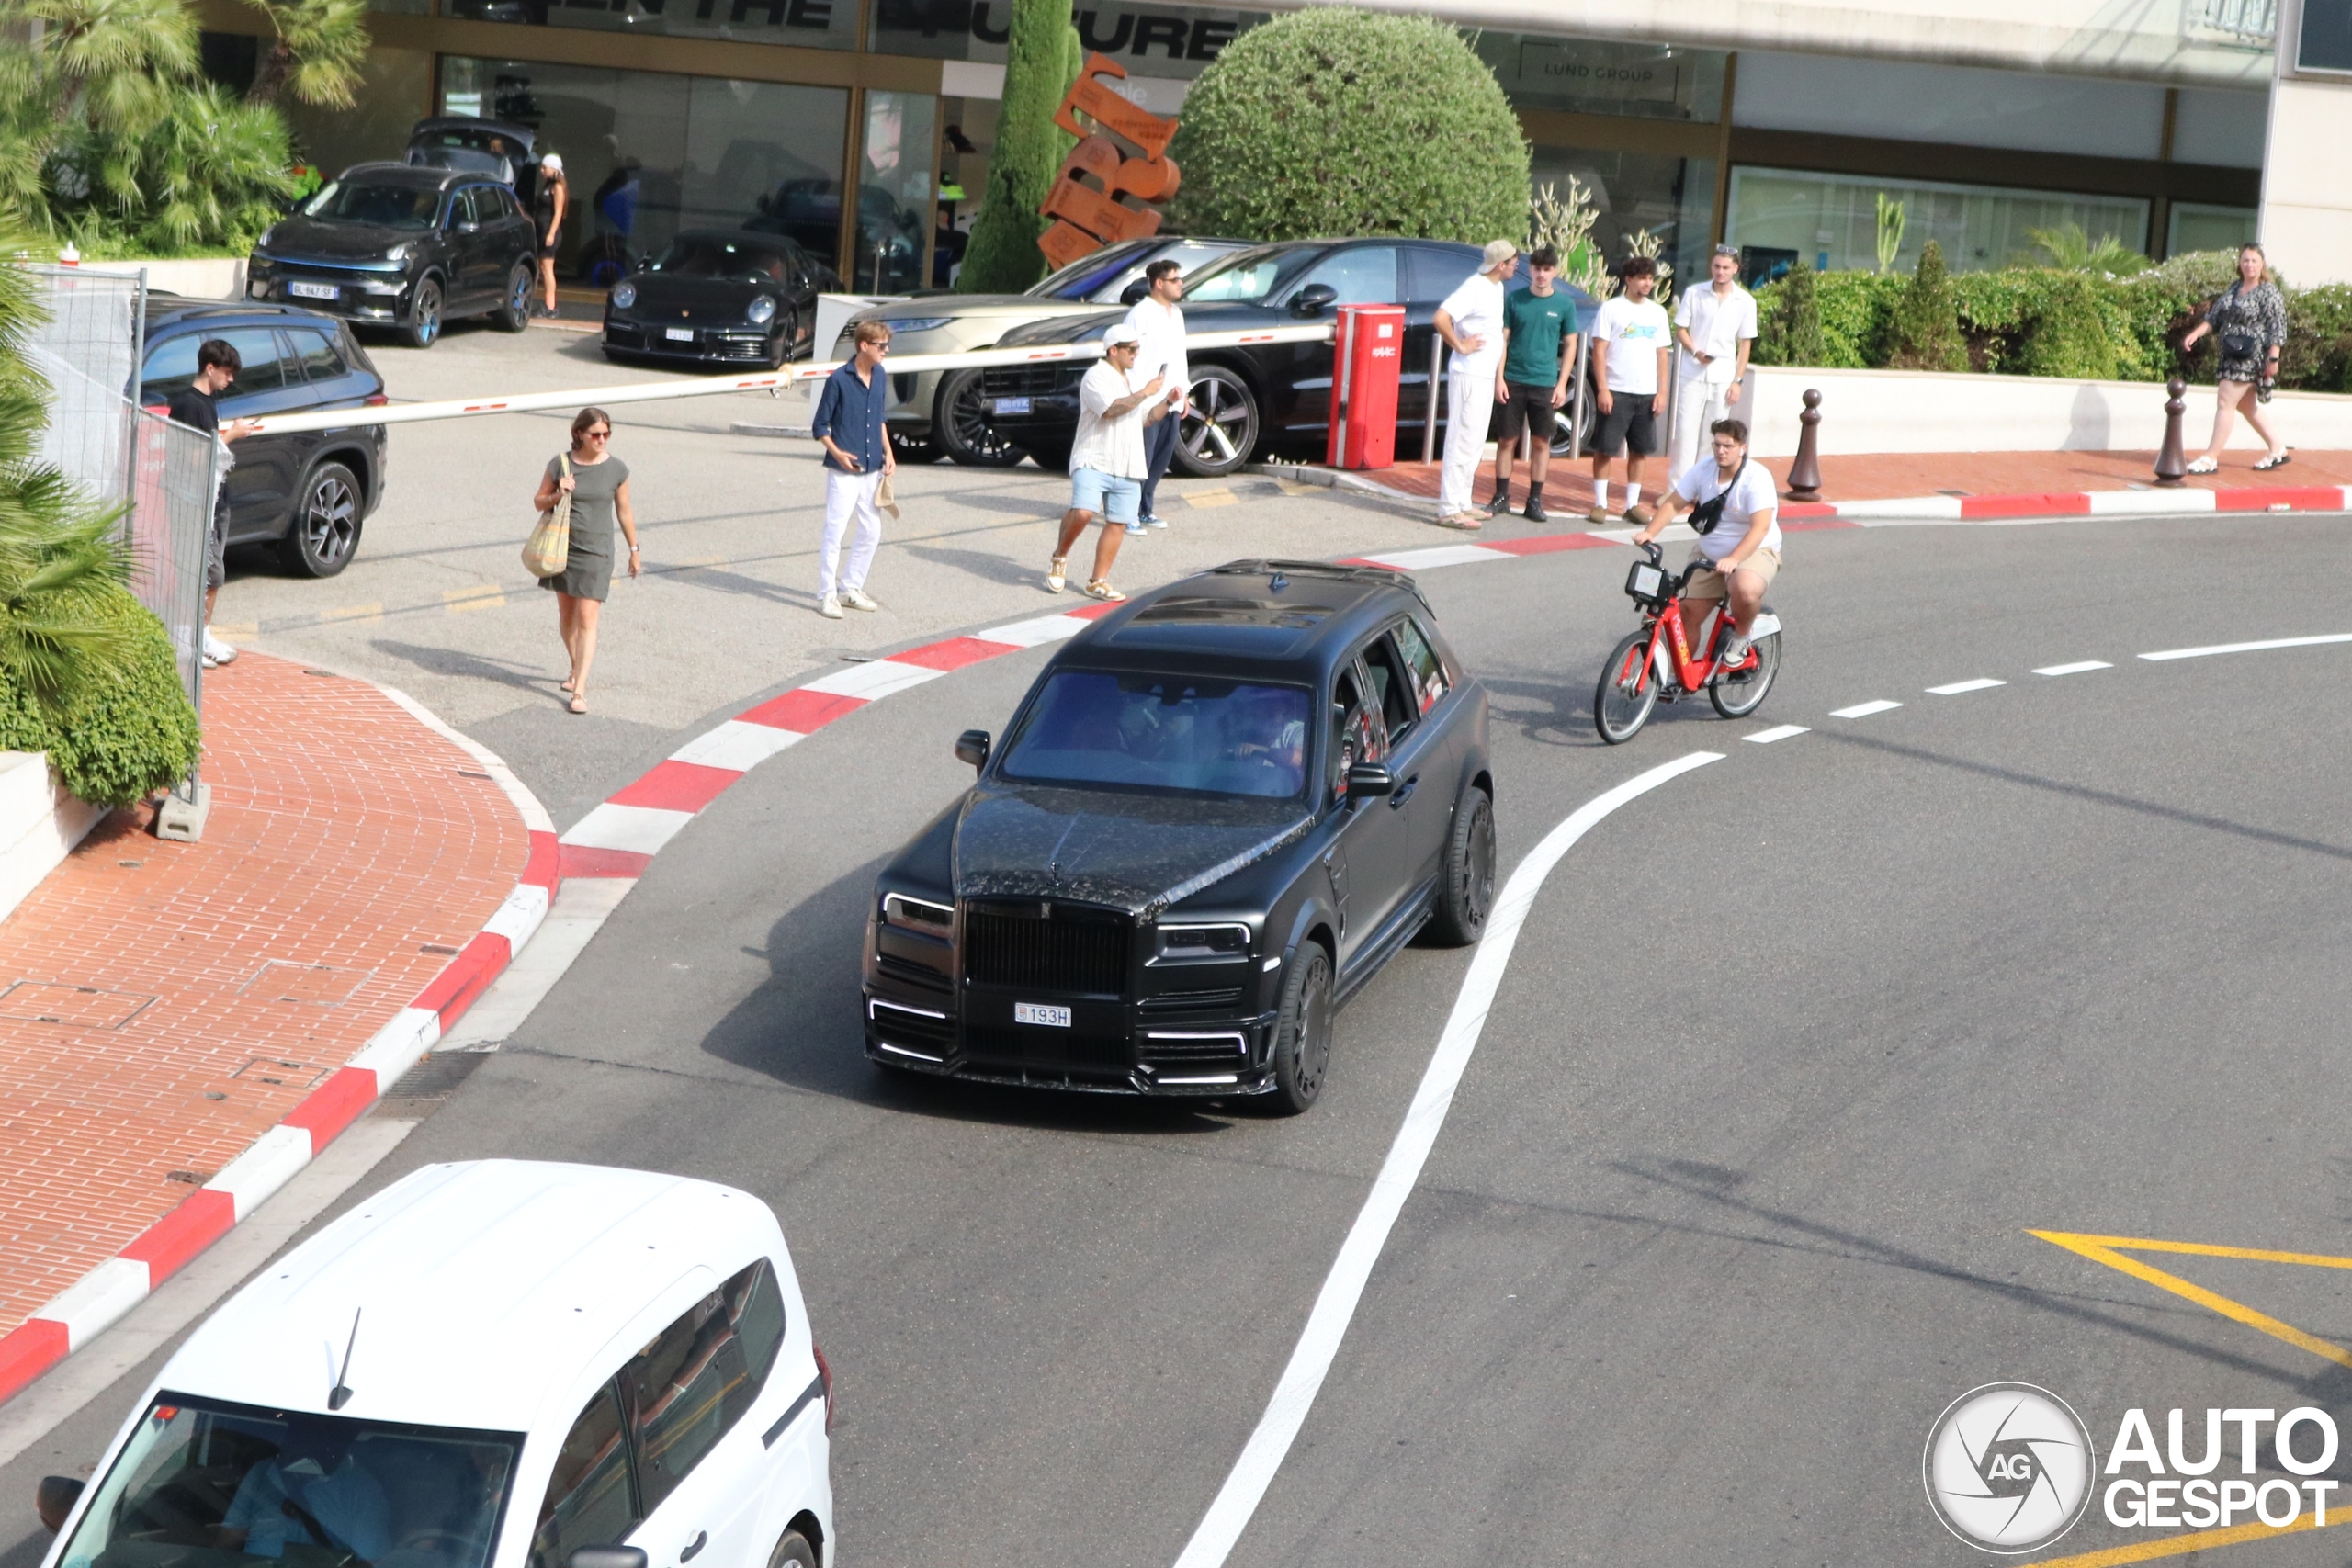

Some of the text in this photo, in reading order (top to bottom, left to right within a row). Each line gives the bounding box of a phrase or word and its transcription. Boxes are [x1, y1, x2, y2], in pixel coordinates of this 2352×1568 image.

[1544, 63, 1654, 82] LUND GROUP
[1031, 1008, 1068, 1025] 193H
